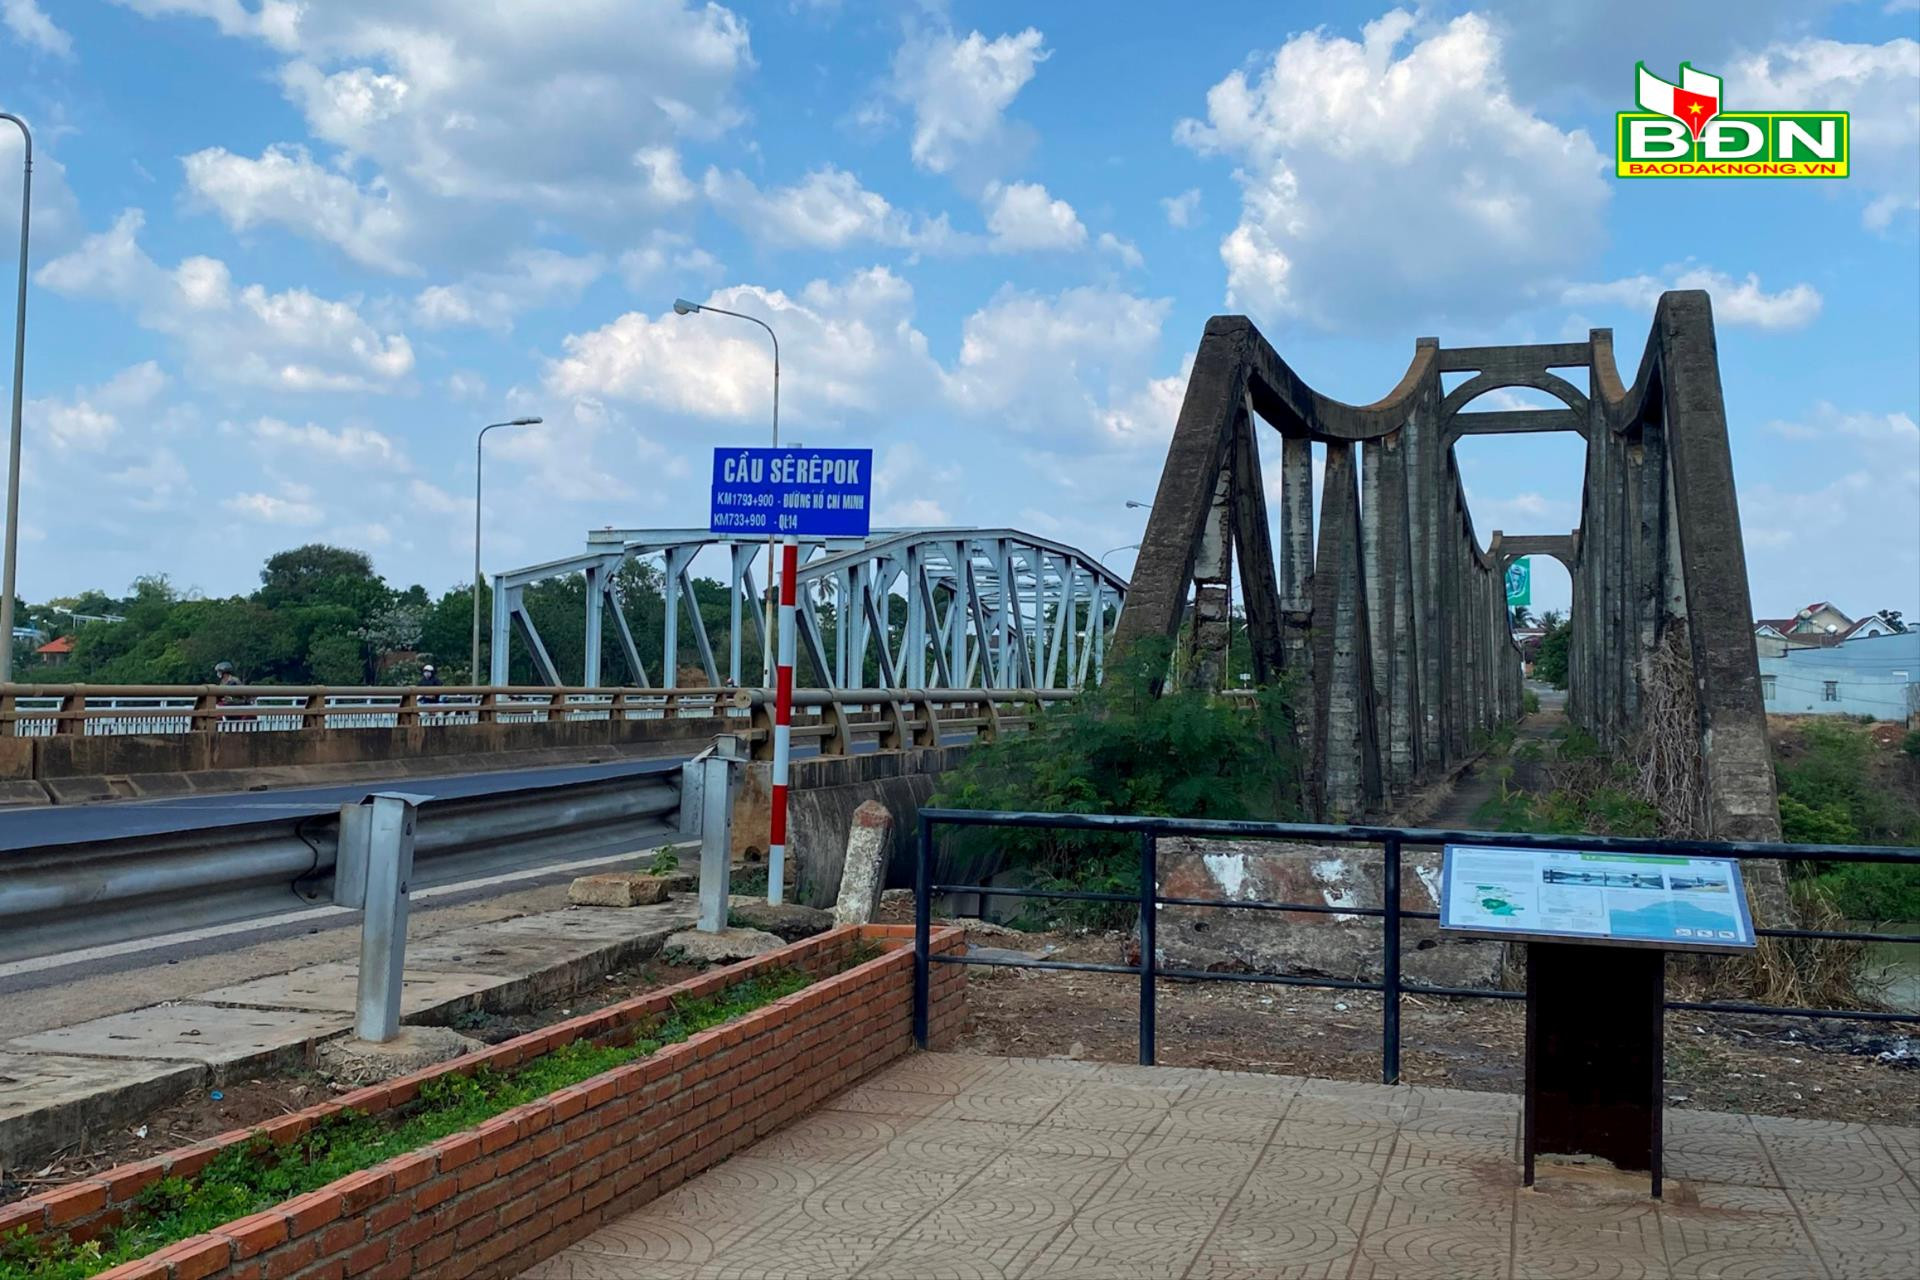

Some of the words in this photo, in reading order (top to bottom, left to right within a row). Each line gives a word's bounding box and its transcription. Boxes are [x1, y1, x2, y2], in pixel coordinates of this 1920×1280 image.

[724, 451, 764, 483] CẦU
[770, 454, 860, 484] SÊRÊPOK
[717, 492, 774, 507] KM1793+900
[843, 494, 864, 510] MINH
[713, 513, 767, 527] KM733+900
